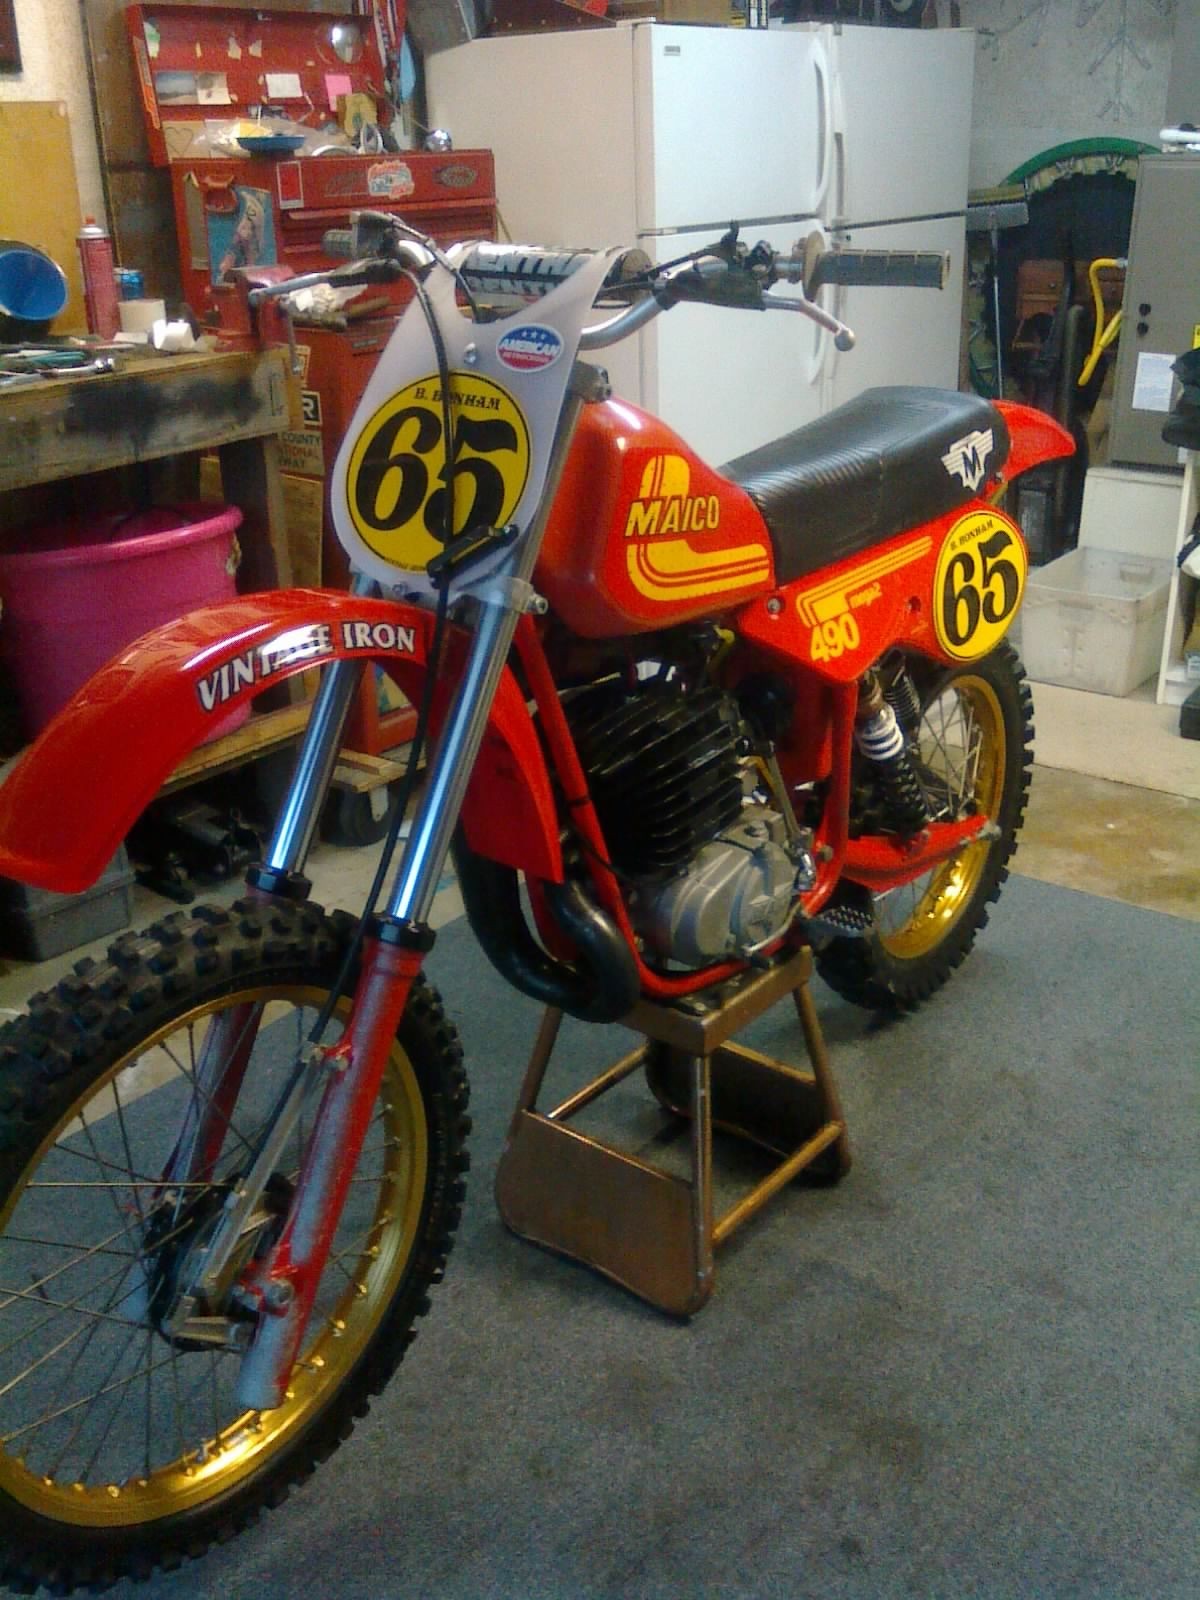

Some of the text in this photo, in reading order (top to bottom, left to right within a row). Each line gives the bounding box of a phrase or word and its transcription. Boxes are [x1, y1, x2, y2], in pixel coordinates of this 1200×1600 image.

[432, 390, 500, 410] BNHAM
[355, 406, 519, 543] 65
[624, 495, 720, 537] MAICO
[958, 519, 994, 546] BONHAM
[943, 530, 1014, 646] 65
[810, 612, 860, 662] 490
[198, 622, 416, 712] VINTE IRON
